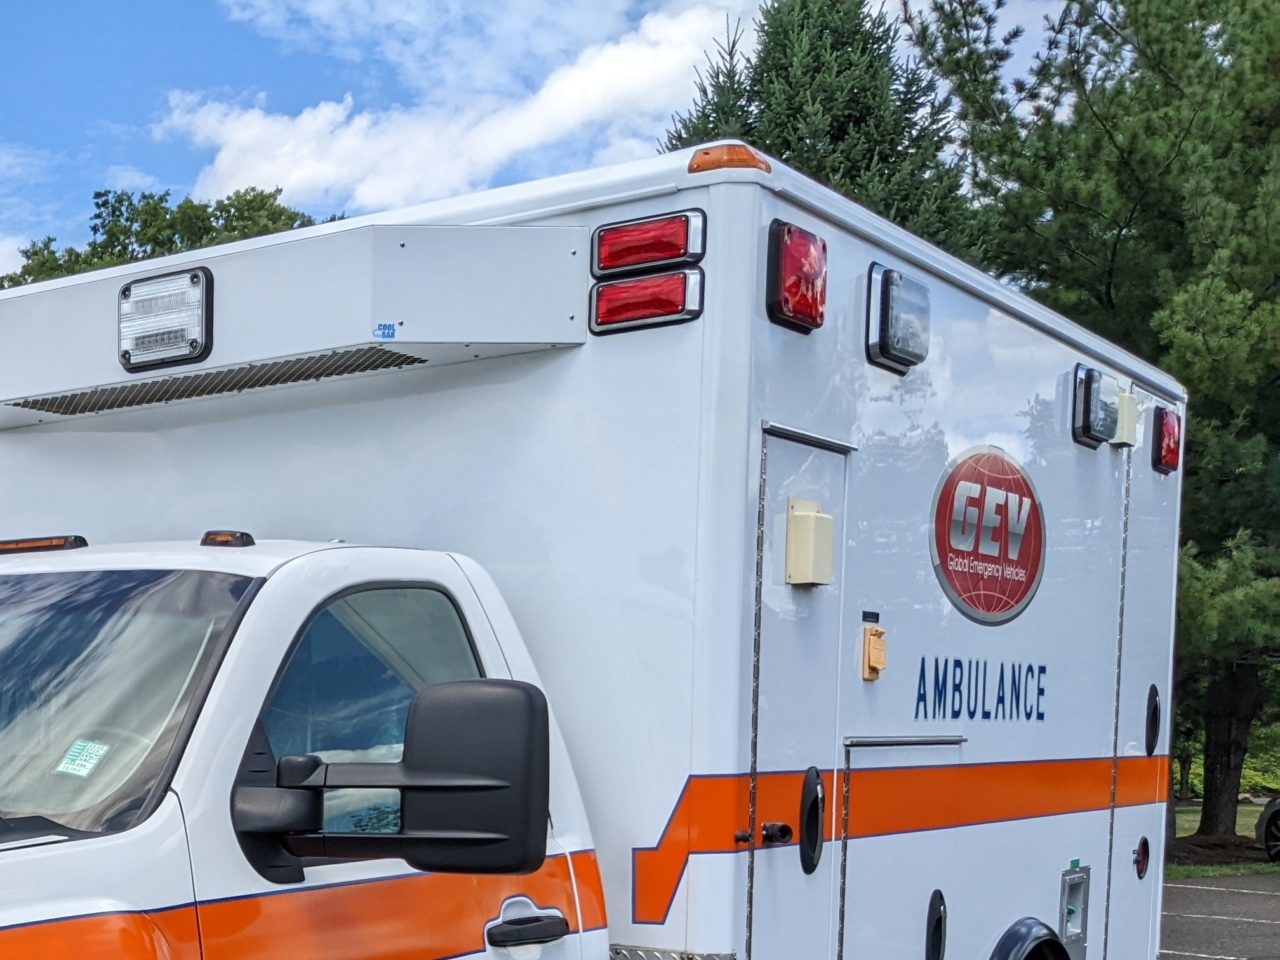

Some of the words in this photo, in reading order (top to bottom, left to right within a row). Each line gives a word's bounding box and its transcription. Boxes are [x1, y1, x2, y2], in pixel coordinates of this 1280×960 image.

[949, 480, 1031, 561] GEV
[947, 553, 969, 572] Global
[969, 556, 1002, 580] Emergency
[1003, 562, 1026, 581] Vehicles
[914, 656, 1047, 722] AMBULANCE
